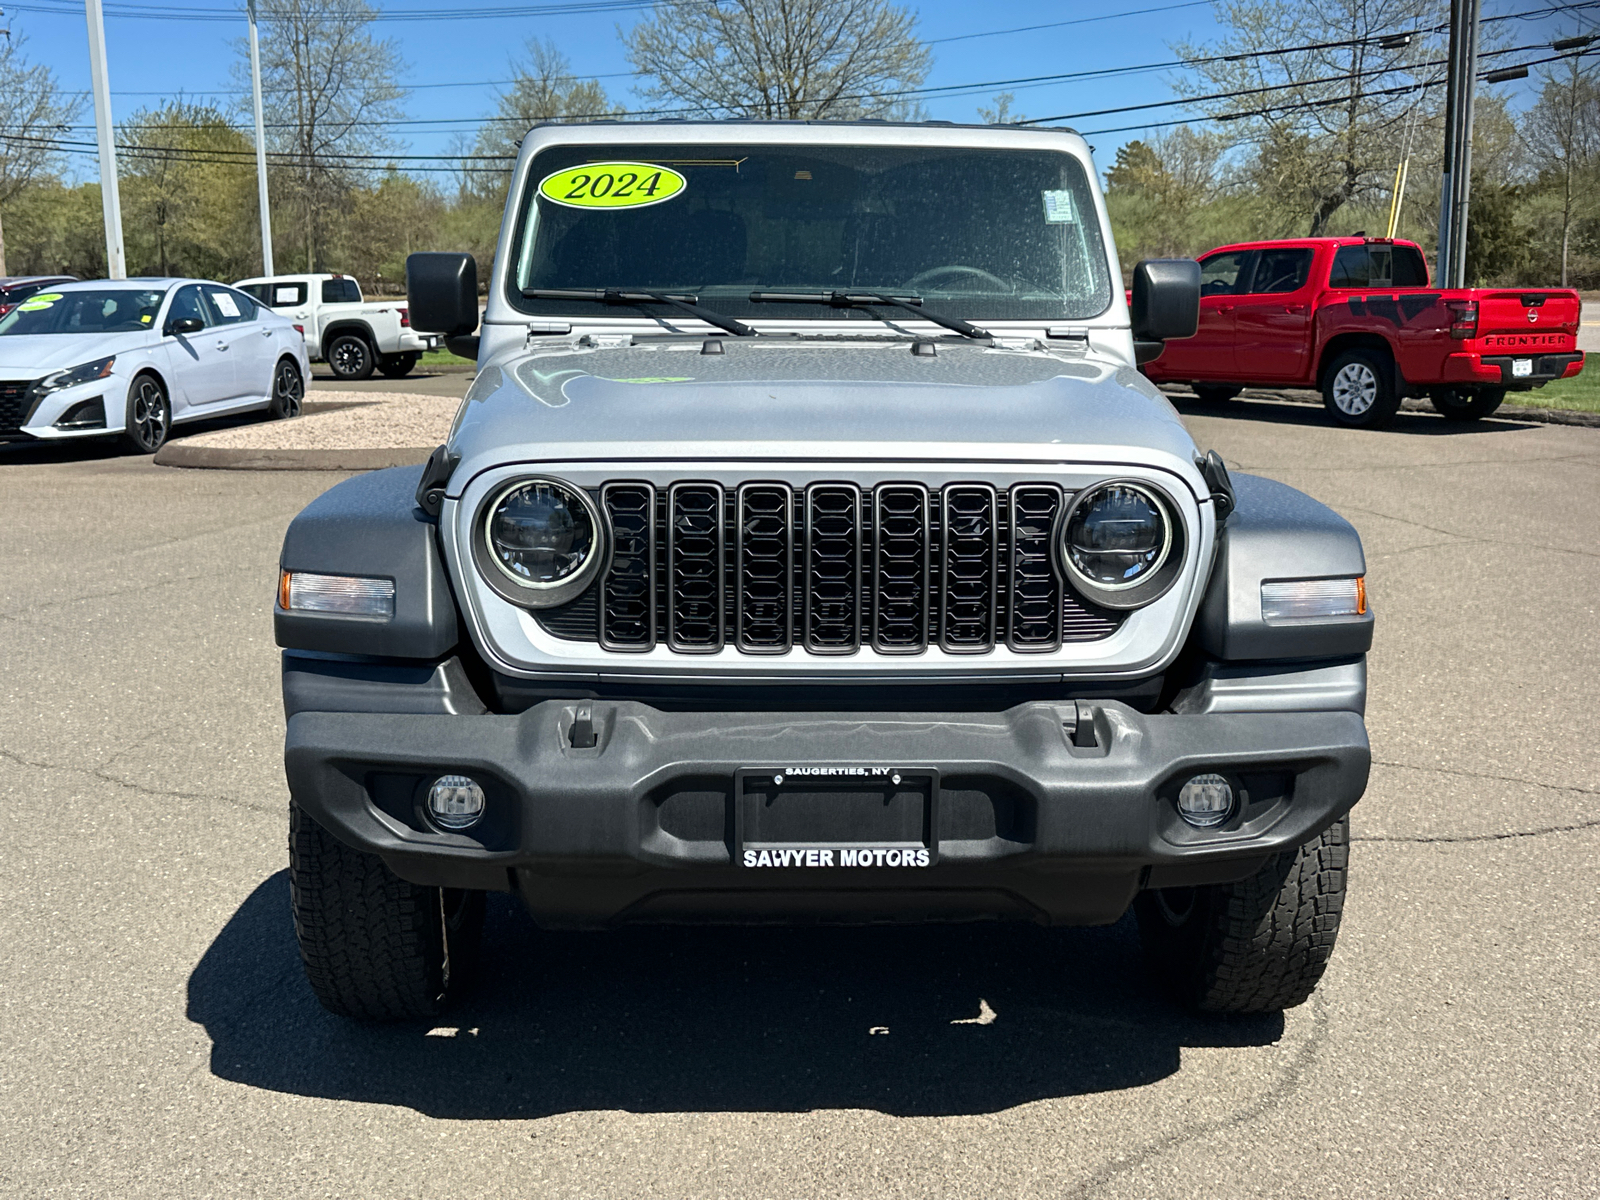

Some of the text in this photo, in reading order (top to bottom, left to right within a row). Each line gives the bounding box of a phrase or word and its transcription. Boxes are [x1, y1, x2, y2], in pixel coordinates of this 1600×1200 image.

[564, 172, 662, 200] 2024
[1485, 335, 1567, 346] FRONTIER
[785, 767, 891, 777] SAUGERTIES, NY
[743, 849, 931, 868] SAWYER MOTORS
